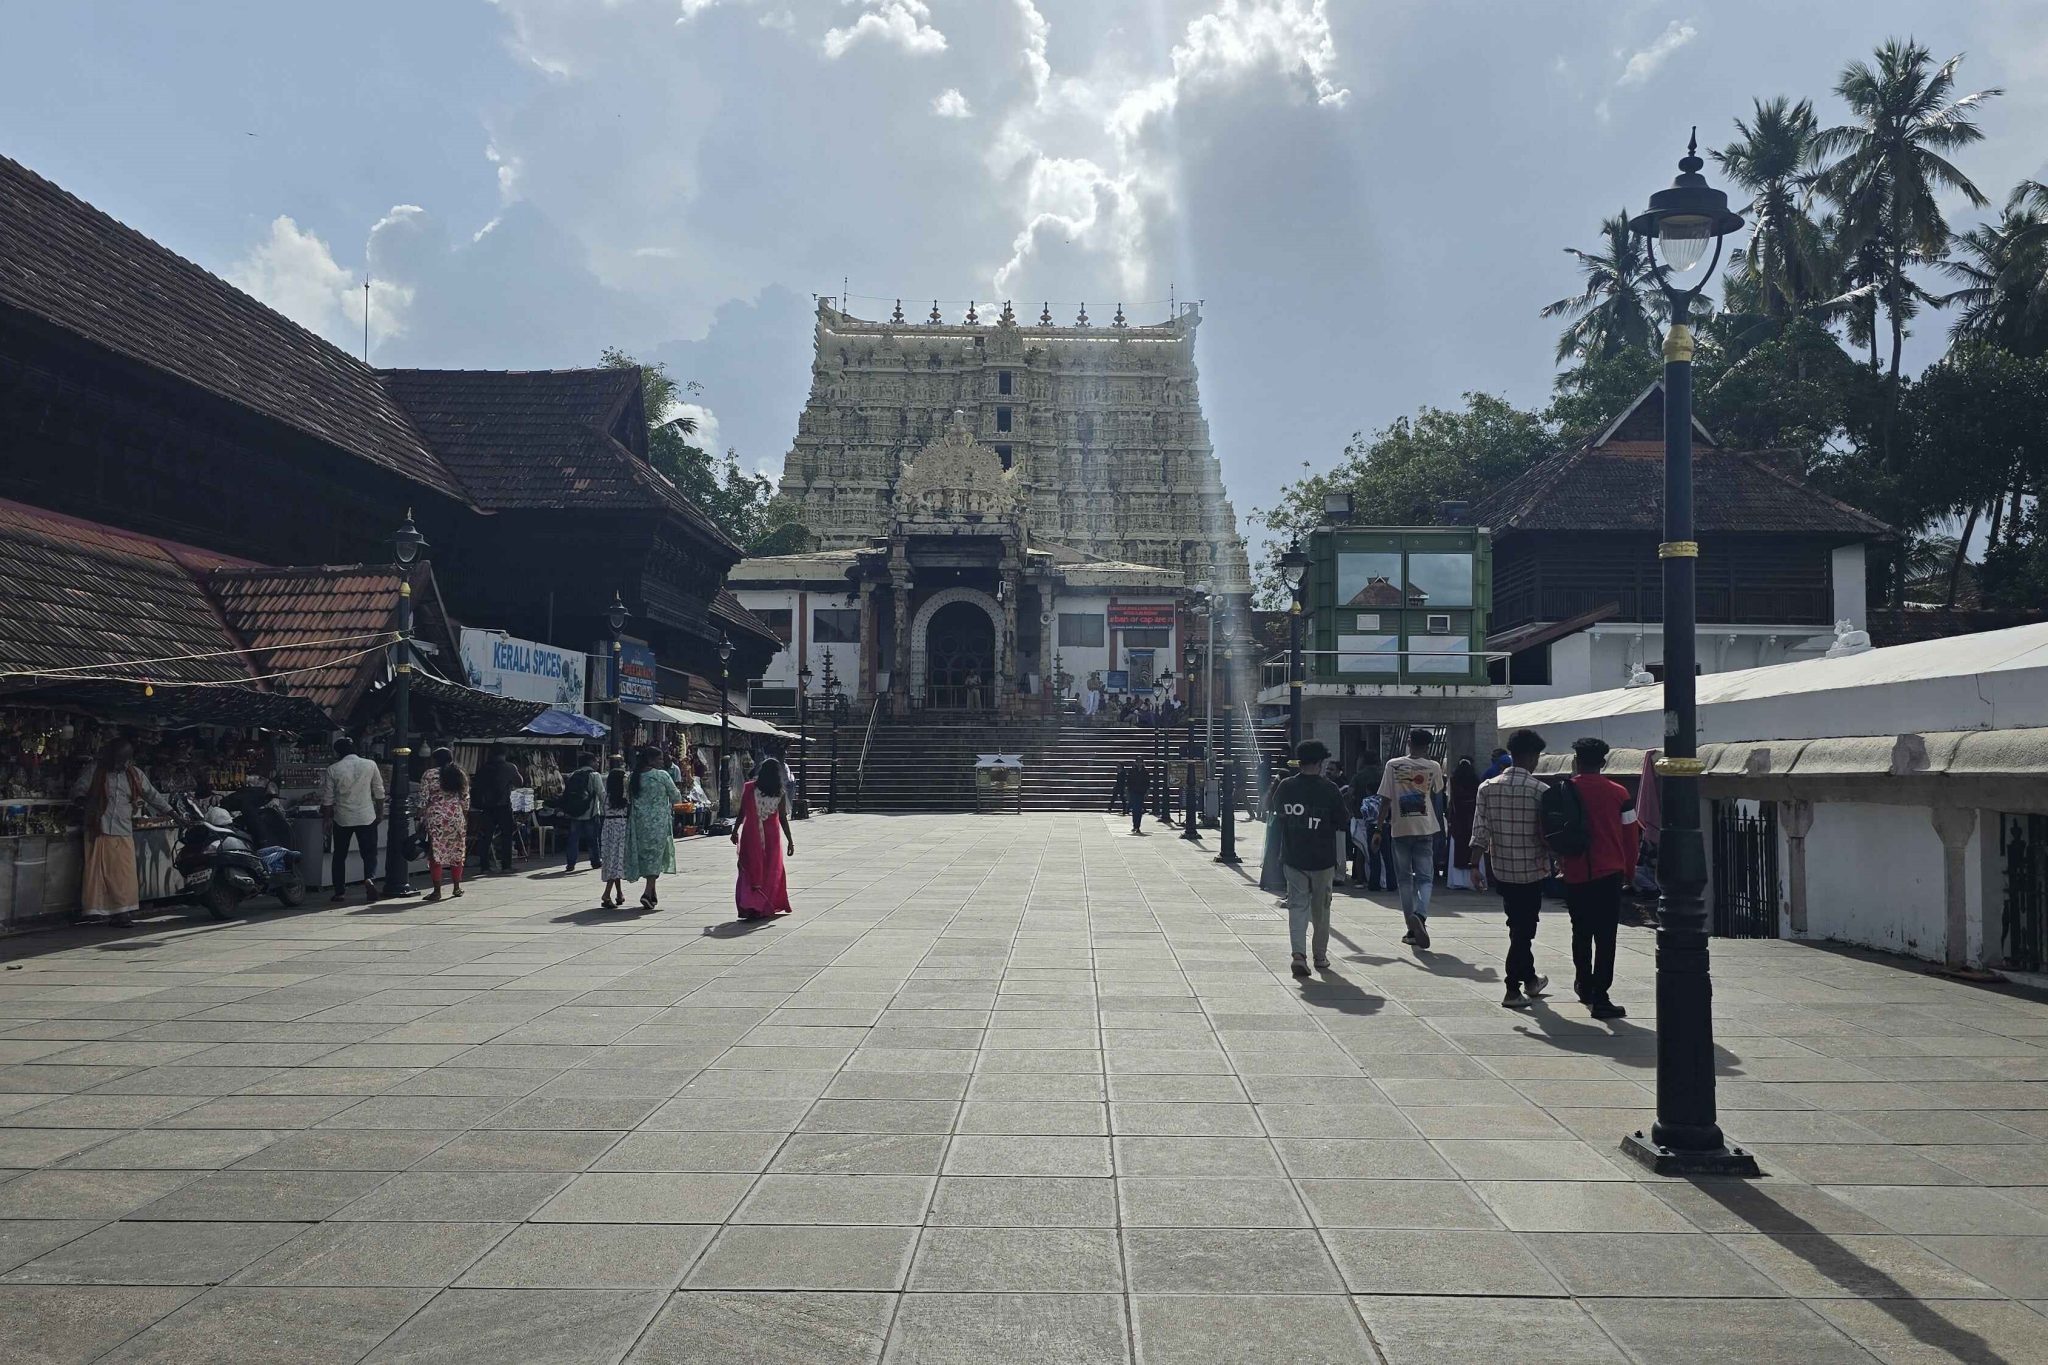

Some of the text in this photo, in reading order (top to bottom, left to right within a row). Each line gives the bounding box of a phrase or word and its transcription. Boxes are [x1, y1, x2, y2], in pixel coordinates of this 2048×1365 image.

[493, 641, 561, 678] KERALA SPICES
[1284, 803, 1305, 816] DO
[1308, 816, 1322, 830] IT
